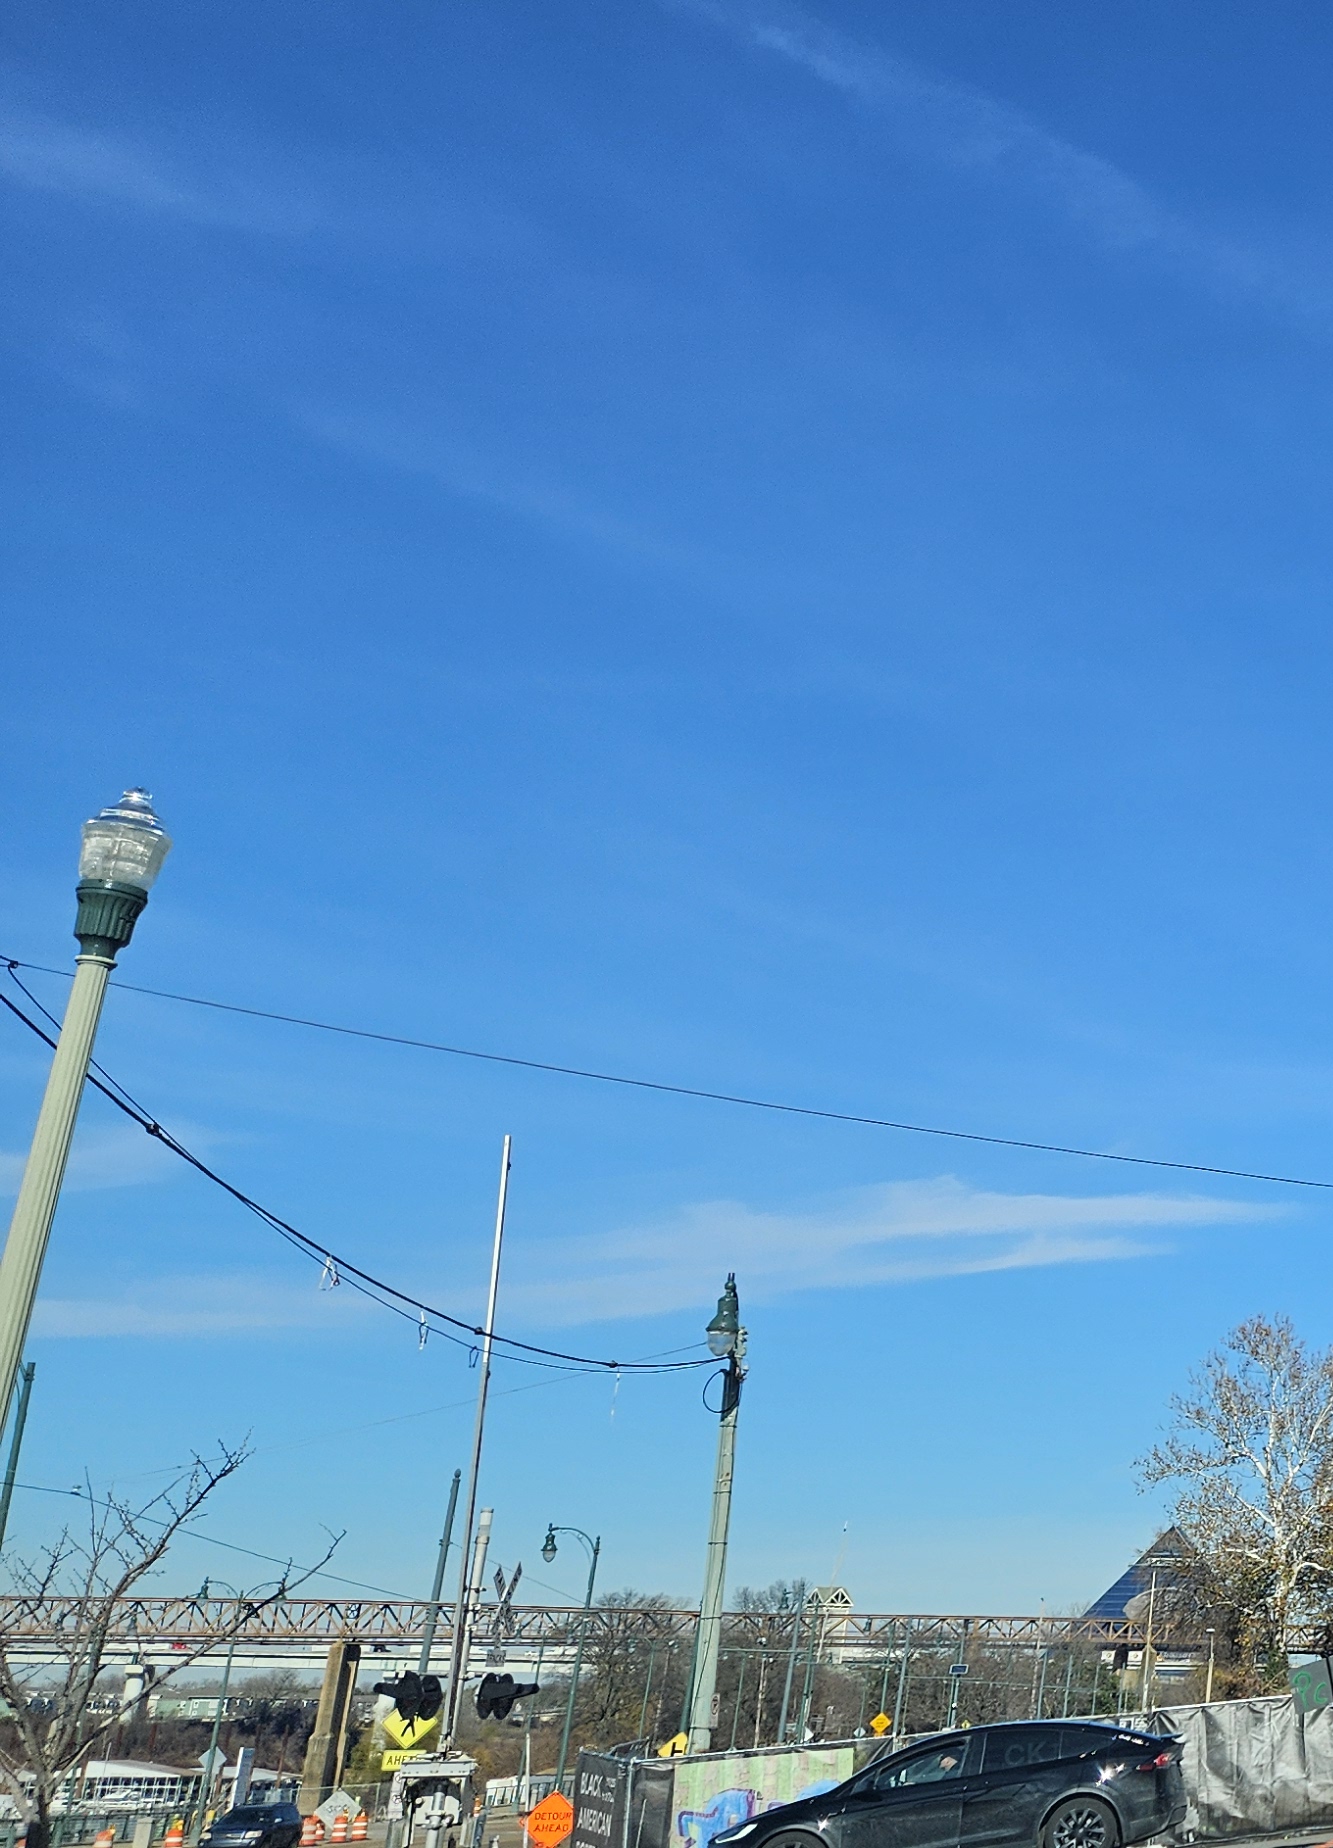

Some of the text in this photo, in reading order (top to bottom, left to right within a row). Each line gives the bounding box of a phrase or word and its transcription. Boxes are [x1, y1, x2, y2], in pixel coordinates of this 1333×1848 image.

[580, 1771, 604, 1798] BLACK
[533, 1811, 573, 1822] DETOUR
[576, 1806, 613, 1838] AMERICAN
[532, 1823, 570, 1833] AHEAD
